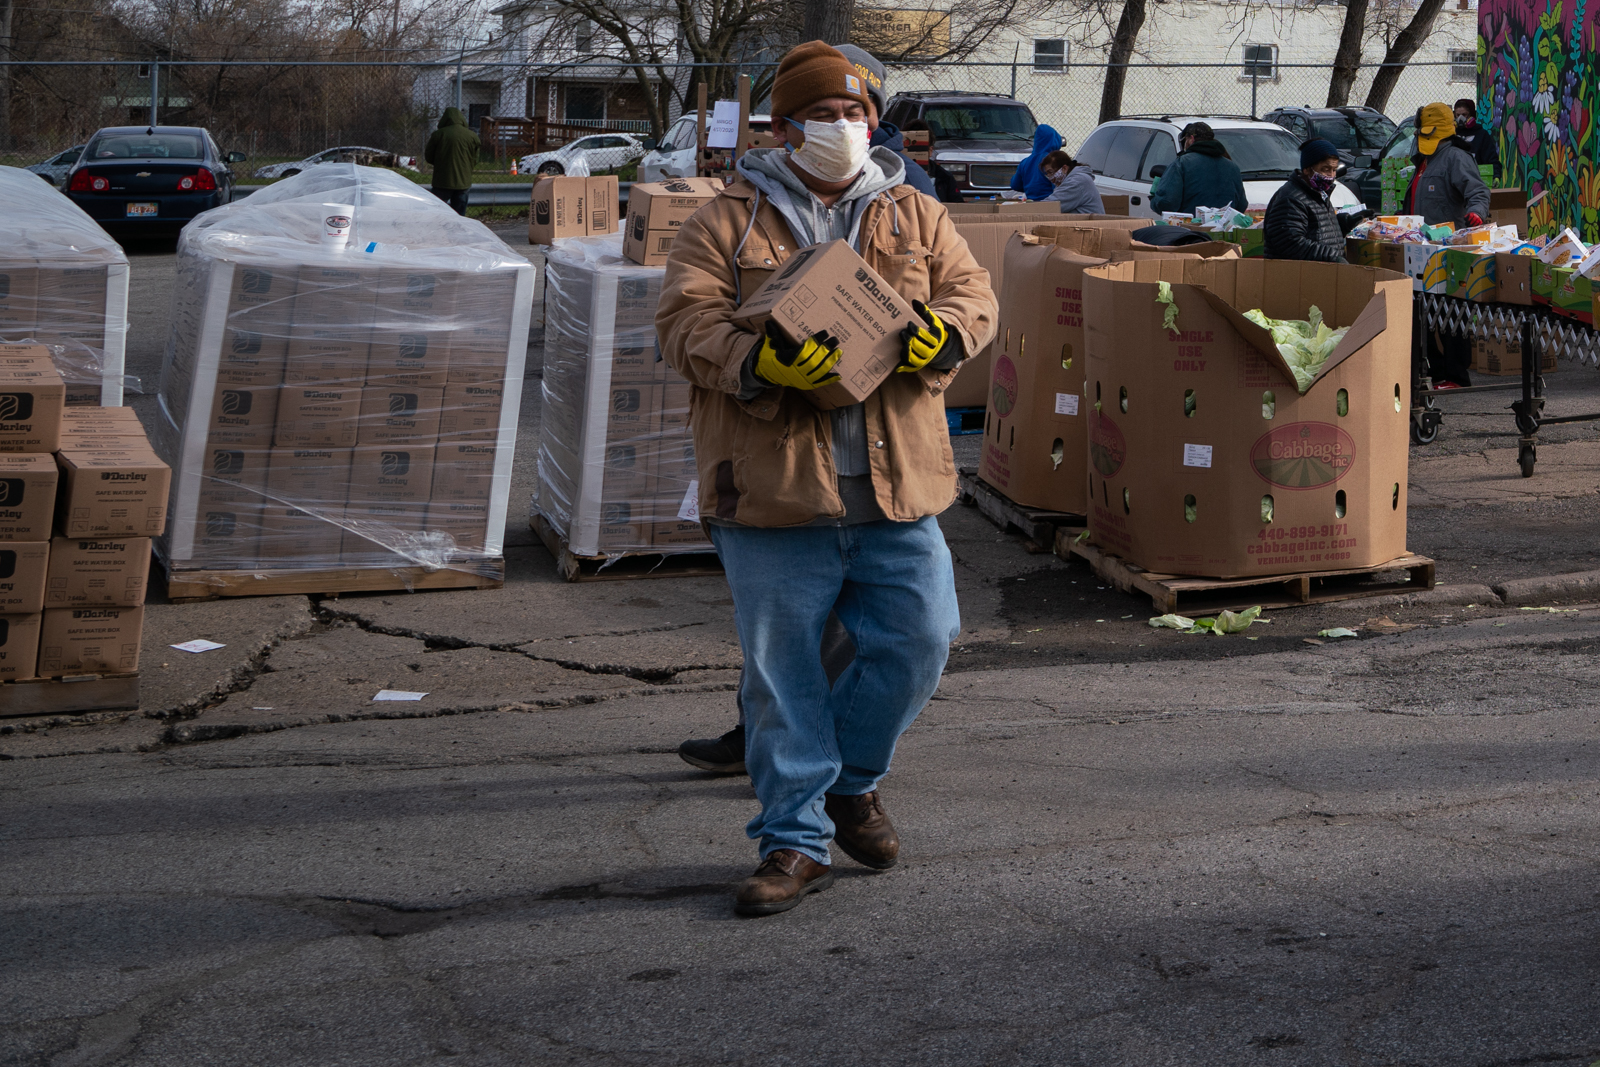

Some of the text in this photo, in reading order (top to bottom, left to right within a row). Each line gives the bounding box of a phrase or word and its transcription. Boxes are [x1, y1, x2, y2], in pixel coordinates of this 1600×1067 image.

[854, 63, 869, 80] FOOD
[863, 276, 902, 320] Darley
[1055, 286, 1083, 301] SINGL
[835, 284, 888, 337] SAFE WATER BOX
[1061, 301, 1081, 314] USE
[830, 296, 847, 313] PREMIUM
[862, 327, 876, 342] WATER
[1057, 314, 1084, 327] ONLY
[1168, 330, 1214, 343] SINGLE
[1178, 345, 1203, 358] USE
[1174, 360, 1207, 372] ONLY
[312, 391, 342, 400] Darley
[218, 416, 250, 426] Darley
[1268, 441, 1342, 463] Cabbage
[111, 472, 148, 481] Darley
[0, 510, 22, 519] rley
[1257, 523, 1348, 541] 440-899-9171
[88, 542, 127, 551] Darley
[1247, 537, 1357, 555] cabbageinc.com
[1257, 551, 1351, 565] VERMILION, OH 44089
[82, 610, 121, 619] Darley
